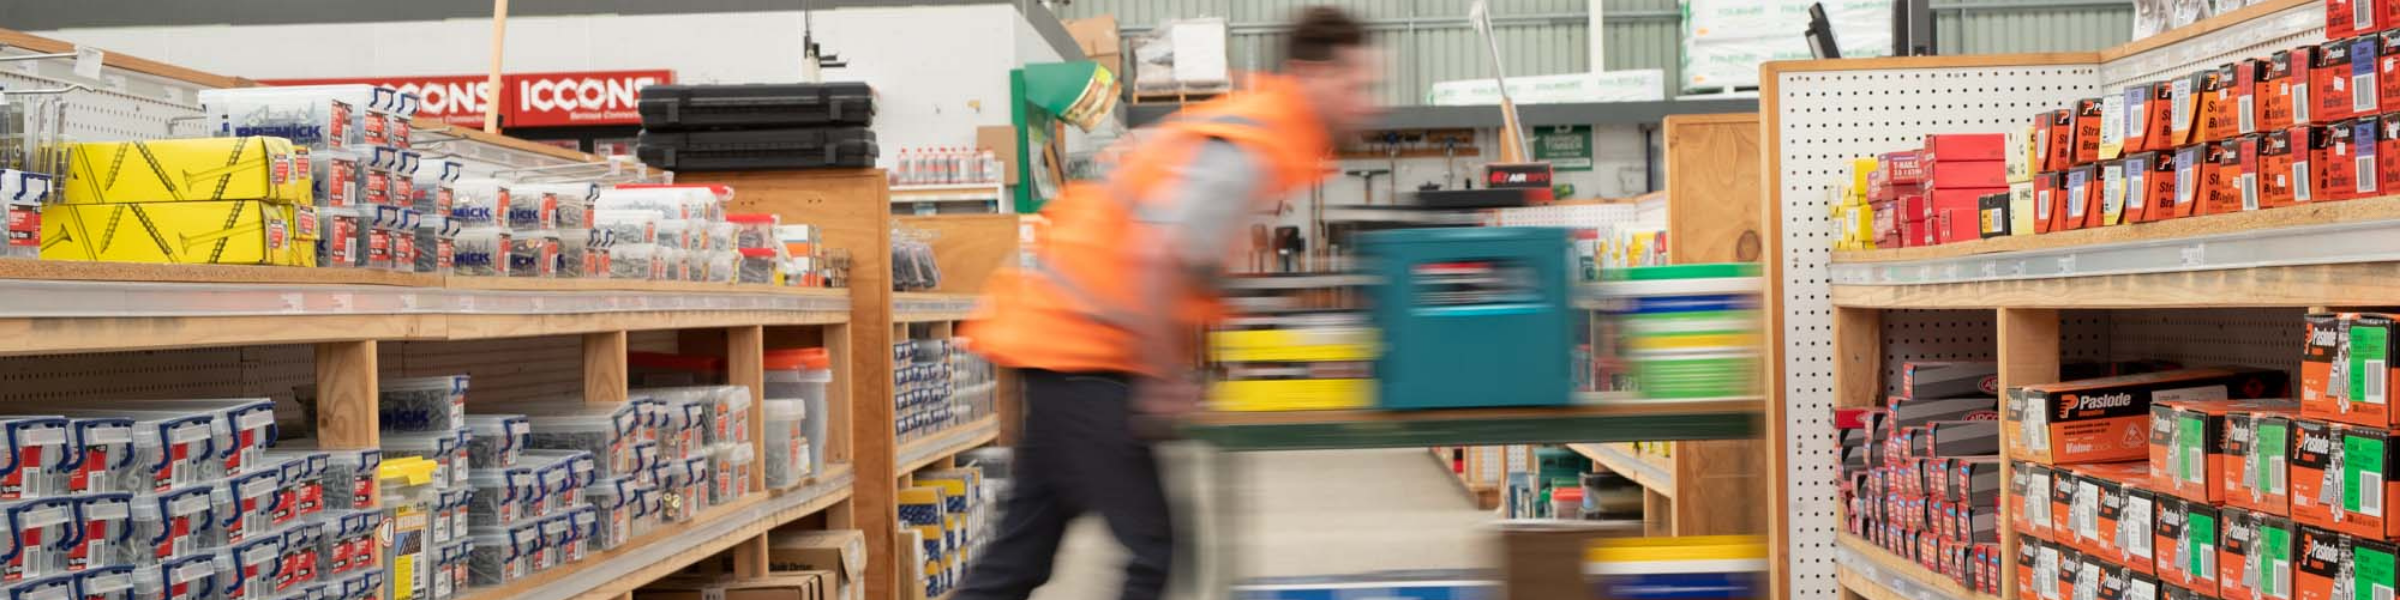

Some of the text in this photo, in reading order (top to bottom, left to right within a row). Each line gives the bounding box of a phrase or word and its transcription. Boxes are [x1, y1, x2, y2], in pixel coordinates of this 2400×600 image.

[2079, 392, 2132, 410] Paslode
[2303, 432, 2330, 455] Paslode
[2311, 539, 2340, 565] Paslode
